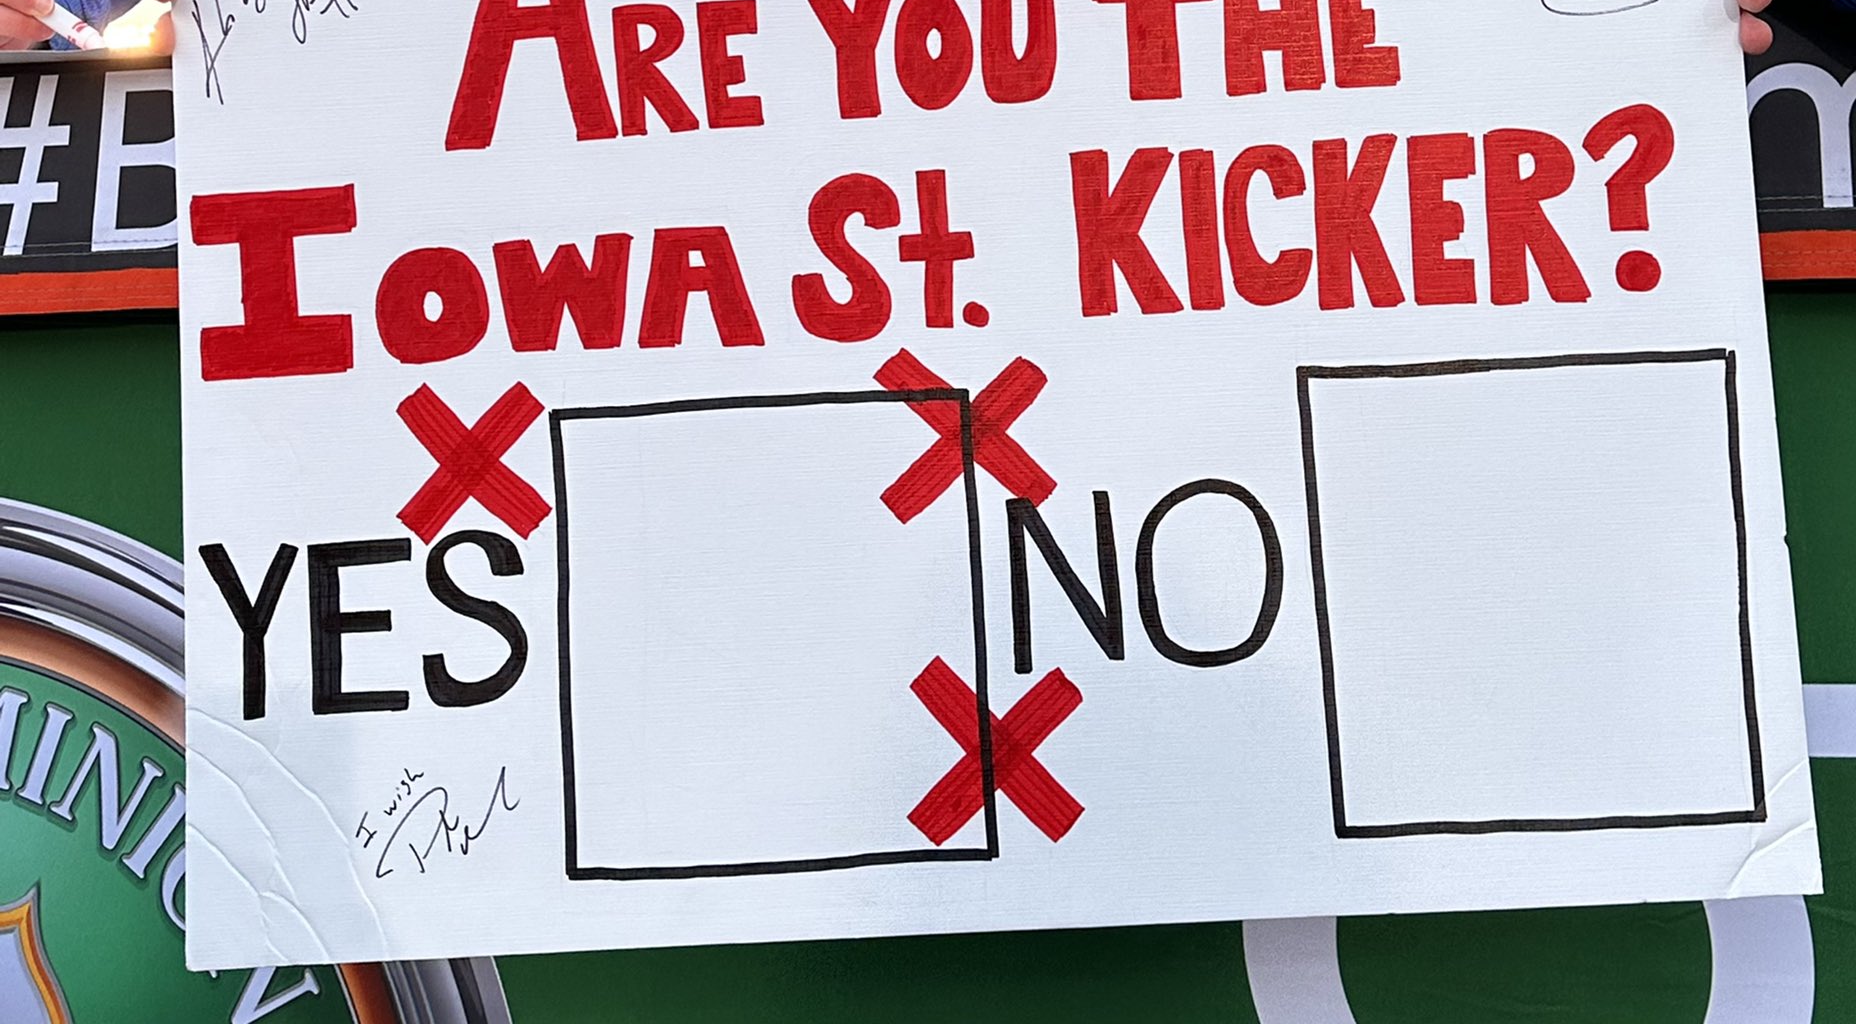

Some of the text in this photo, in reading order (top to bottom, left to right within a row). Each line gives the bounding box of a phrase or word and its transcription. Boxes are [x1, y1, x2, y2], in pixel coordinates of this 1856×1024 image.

[190, 184, 765, 381] IOWA
[1070, 104, 1675, 317] KICKER?
[199, 478, 1284, 721] YES NO
